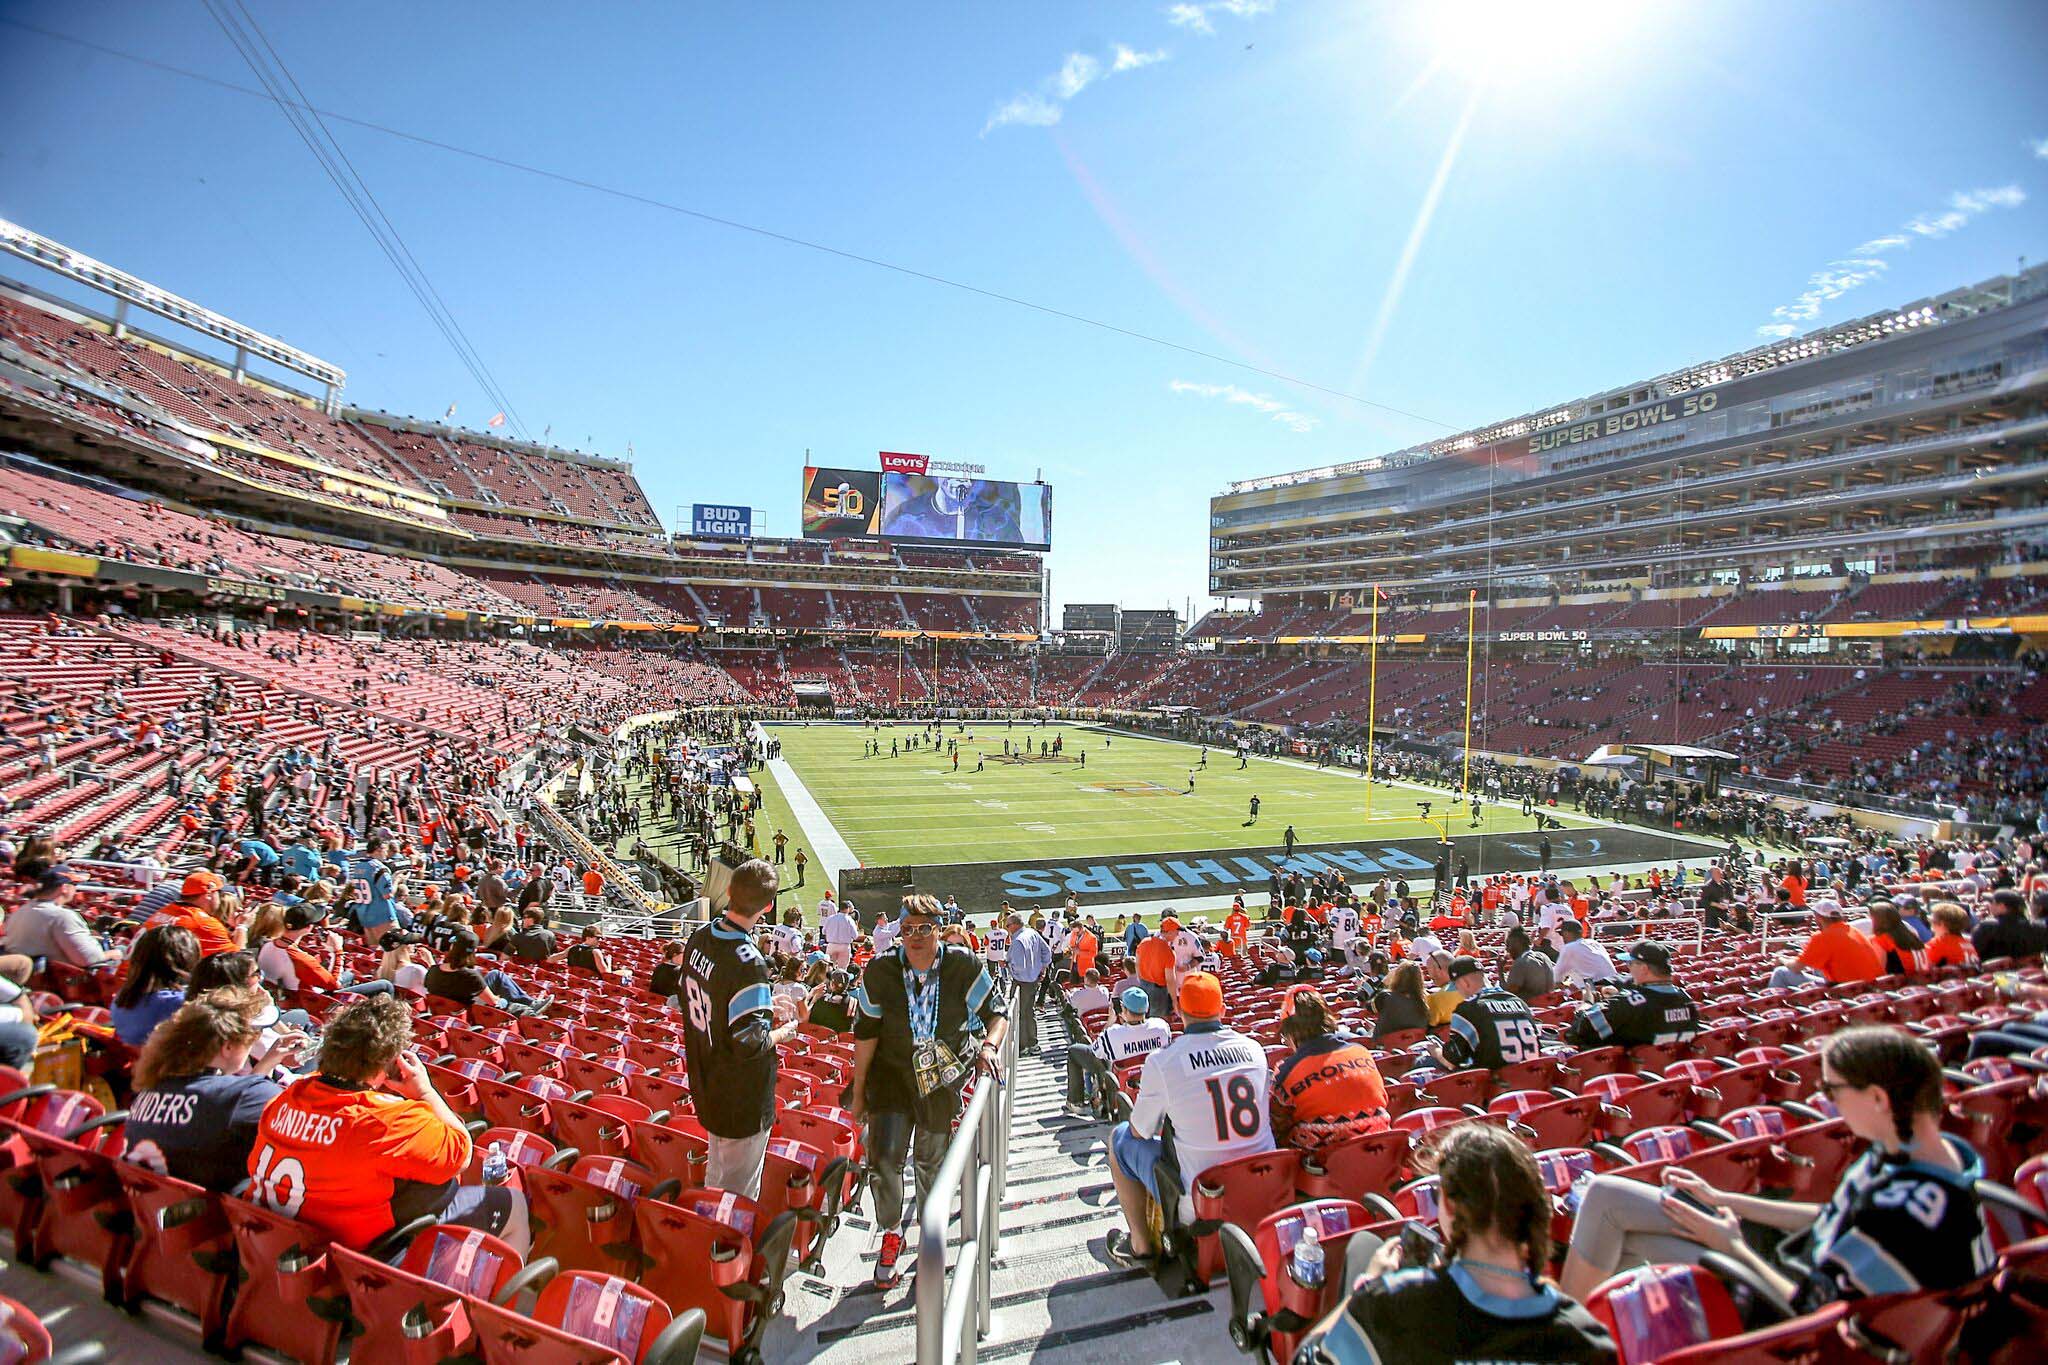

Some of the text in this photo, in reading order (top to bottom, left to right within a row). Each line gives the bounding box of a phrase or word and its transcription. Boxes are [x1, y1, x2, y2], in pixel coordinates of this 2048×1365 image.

[1529, 391, 1718, 454] SUPER BOWL 50
[823, 487, 864, 514] 50
[696, 520, 748, 534] LIGHT
[703, 507, 740, 521] BUD
[715, 627, 746, 635] SUPER
[748, 627, 773, 635] BOWL
[1500, 630, 1587, 641] SUPER BOWL 50
[1001, 847, 1435, 898] PANTHERS
[1233, 921, 1242, 934] 7
[990, 939, 1005, 951] 30
[689, 948, 715, 981] OLSEN
[1124, 1036, 1162, 1055] MANNING
[1494, 1019, 1539, 1062] 59
[1189, 1045, 1254, 1070] MANNING
[1204, 1074, 1260, 1142] 18
[270, 1102, 343, 1145] SANDERS
[252, 1144, 306, 1218] 10
